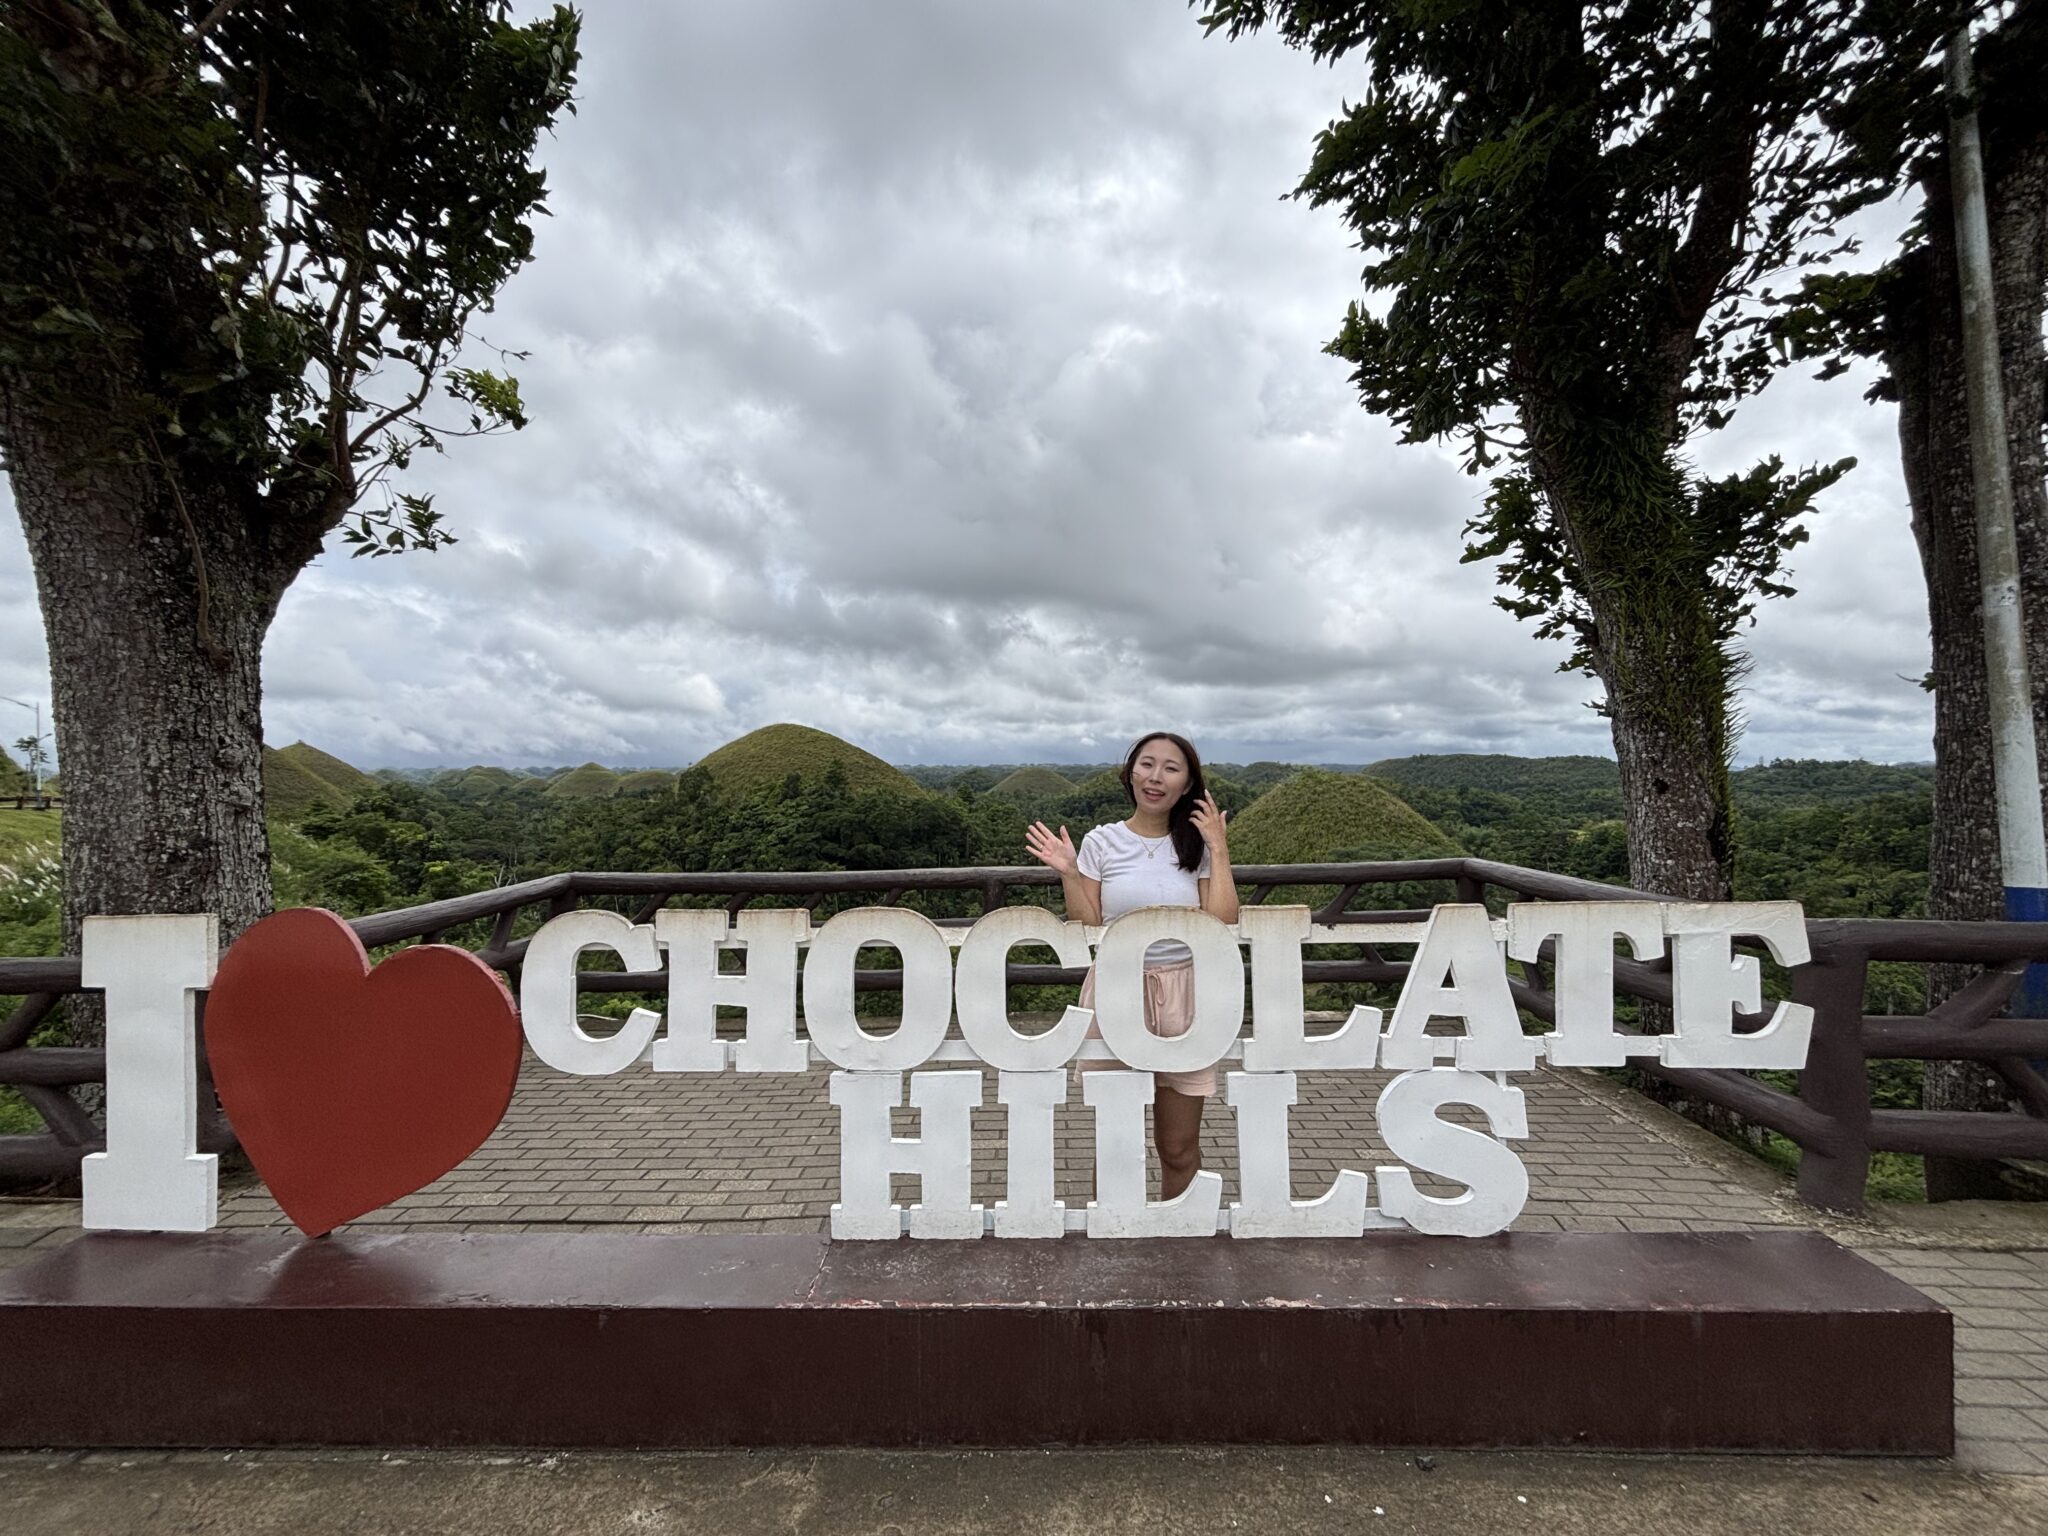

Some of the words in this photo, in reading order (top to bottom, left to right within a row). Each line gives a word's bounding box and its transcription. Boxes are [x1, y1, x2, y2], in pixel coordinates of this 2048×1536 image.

[81, 913, 219, 1232] I
[520, 900, 1815, 1076] CHOCOLATE
[829, 1066, 1529, 1240] HILLS
